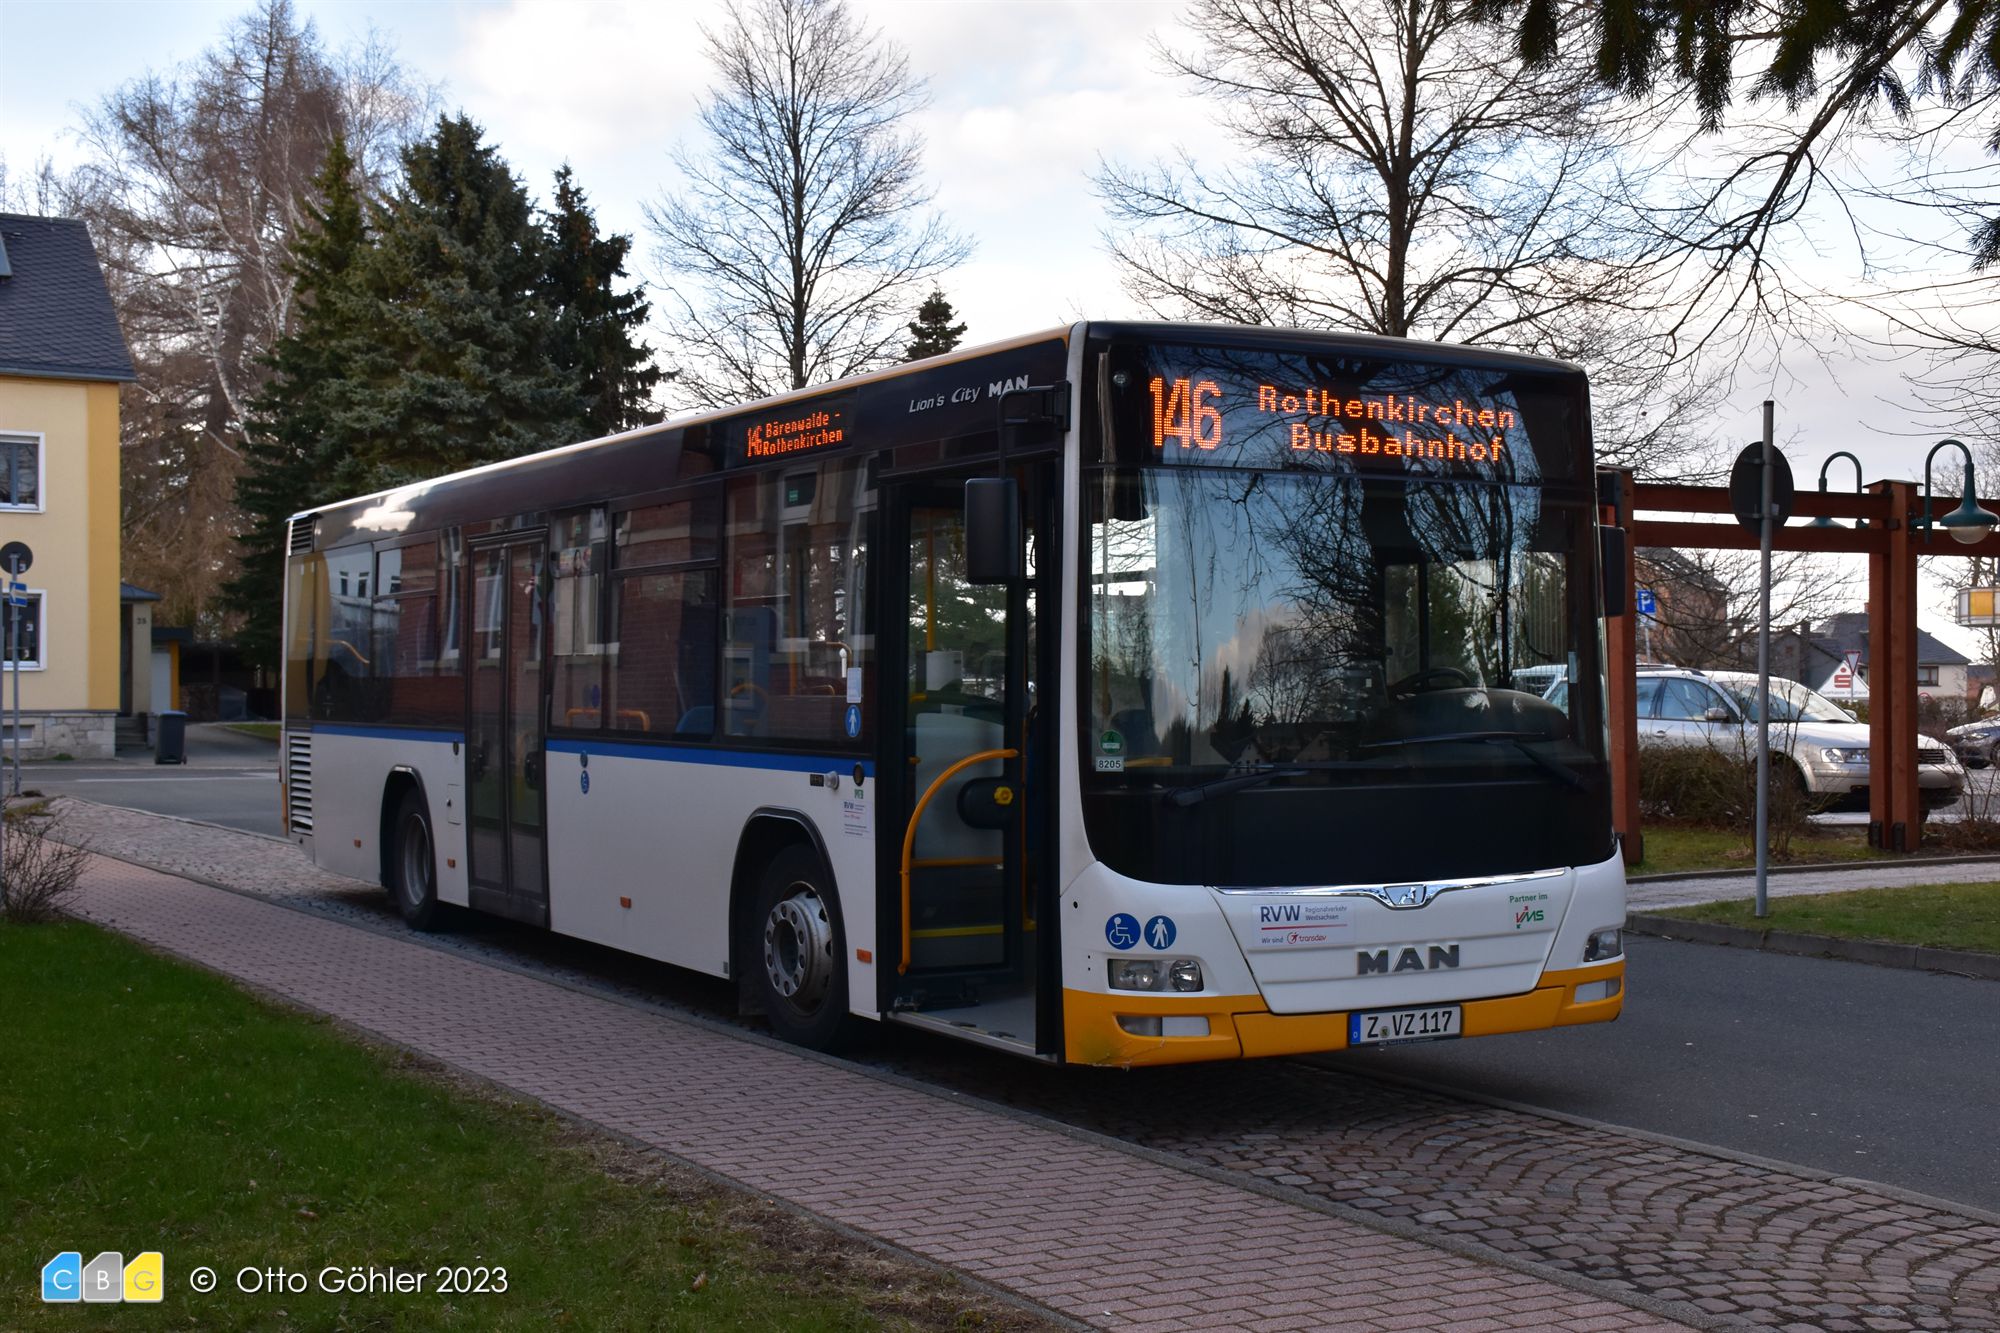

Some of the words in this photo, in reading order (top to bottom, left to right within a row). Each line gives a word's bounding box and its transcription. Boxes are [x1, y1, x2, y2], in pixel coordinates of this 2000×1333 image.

[909, 393, 945, 413] Lion's
[951, 386, 981, 403] City
[988, 374, 1029, 398] MAN
[1149, 376, 1222, 449] 146
[1258, 385, 1514, 429] Rothenkirchen
[766, 411, 829, 438] Bärenwalde
[763, 429, 843, 456] Rothenkirchen
[1291, 423, 1502, 462] Busbahnhof
[1098, 760, 1121, 769] 8205
[1305, 906, 1348, 914] Regionalverkehr
[1509, 894, 1537, 903] Partner
[1538, 892, 1548, 900] im
[1260, 905, 1301, 922] RVW
[1516, 909, 1544, 923] VMS
[1261, 936, 1271, 944] Wir
[1357, 944, 1459, 975] MAN
[1367, 1016, 1379, 1039] Z
[1419, 1010, 1453, 1034] 117
